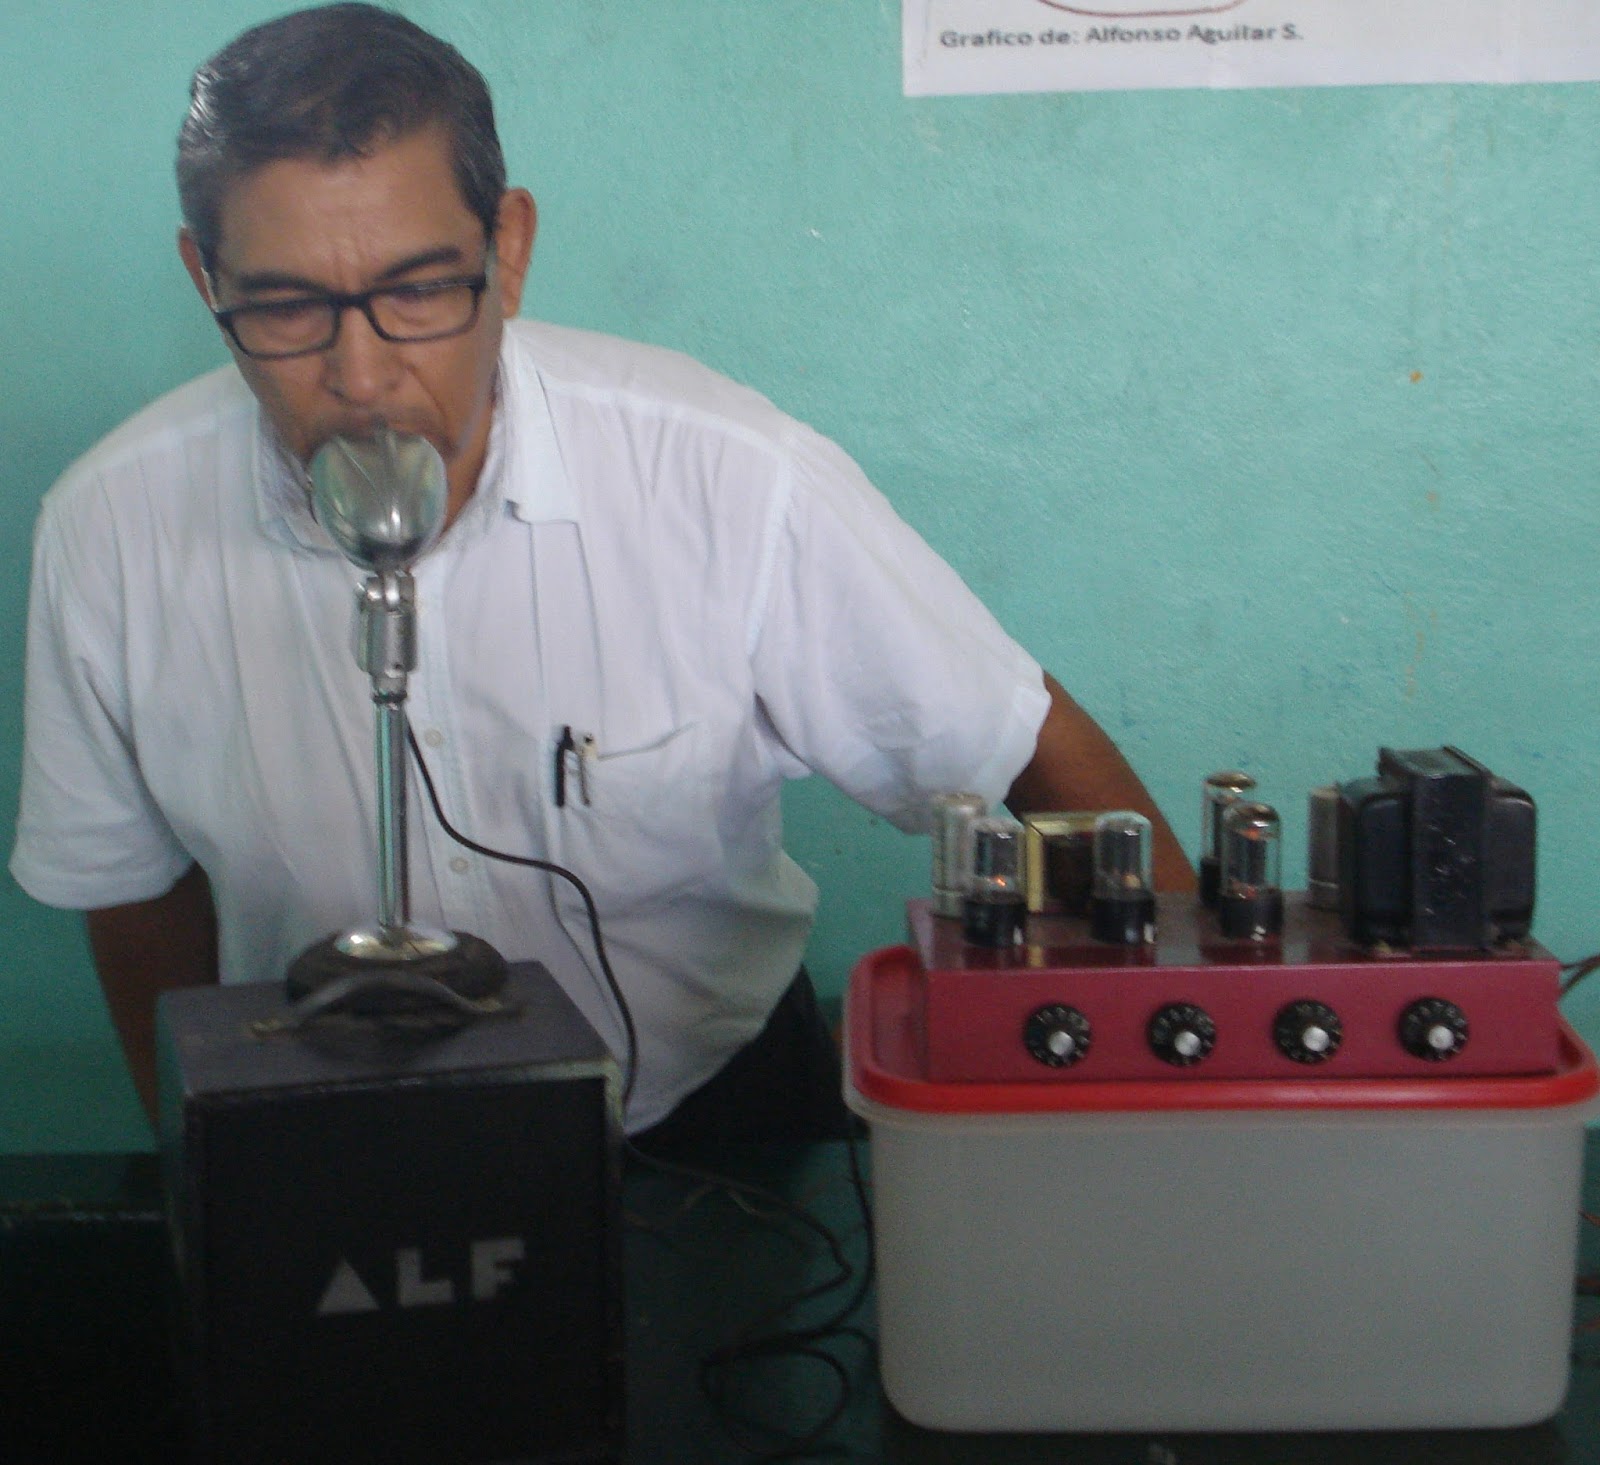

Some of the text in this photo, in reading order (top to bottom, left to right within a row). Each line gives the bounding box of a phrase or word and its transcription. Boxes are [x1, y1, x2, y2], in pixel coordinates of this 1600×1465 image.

[939, 23, 1304, 48] Grafico de: Alfonso Aguilar S.
[316, 1239, 525, 1314] ALF
